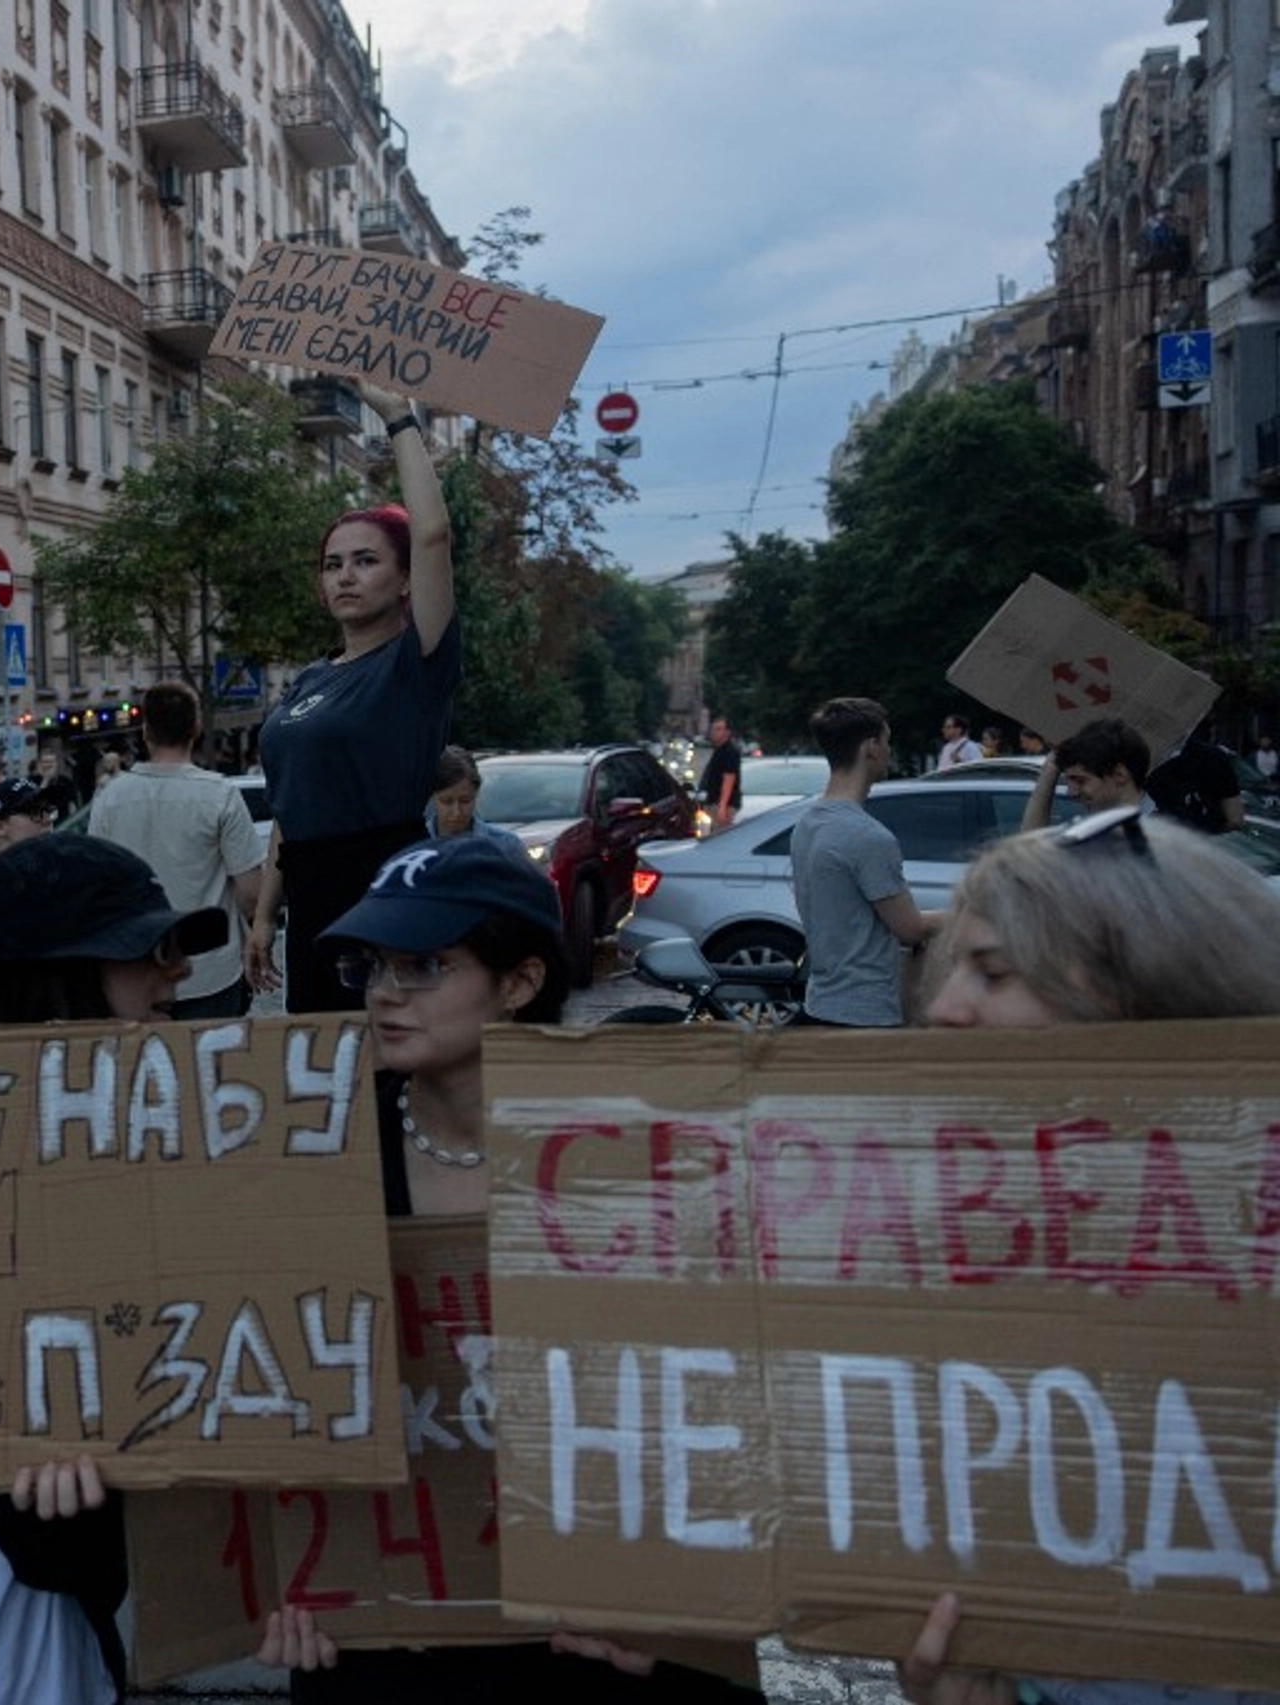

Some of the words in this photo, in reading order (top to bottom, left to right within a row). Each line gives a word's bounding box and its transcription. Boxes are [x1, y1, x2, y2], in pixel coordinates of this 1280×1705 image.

[252, 244, 287, 275] Я
[287, 249, 351, 281] ТУТ
[350, 257, 436, 300] БАЧУ
[441, 280, 520, 330] ВСЕ
[355, 295, 491, 364] ЗАКРИЙ
[306, 324, 432, 387] ЄБАЛО
[37, 1020, 370, 1166] НАБУ
[546, 1346, 755, 1550] НЕ
[820, 1352, 1280, 1593] ПРОД
[222, 1476, 500, 1622] 124
